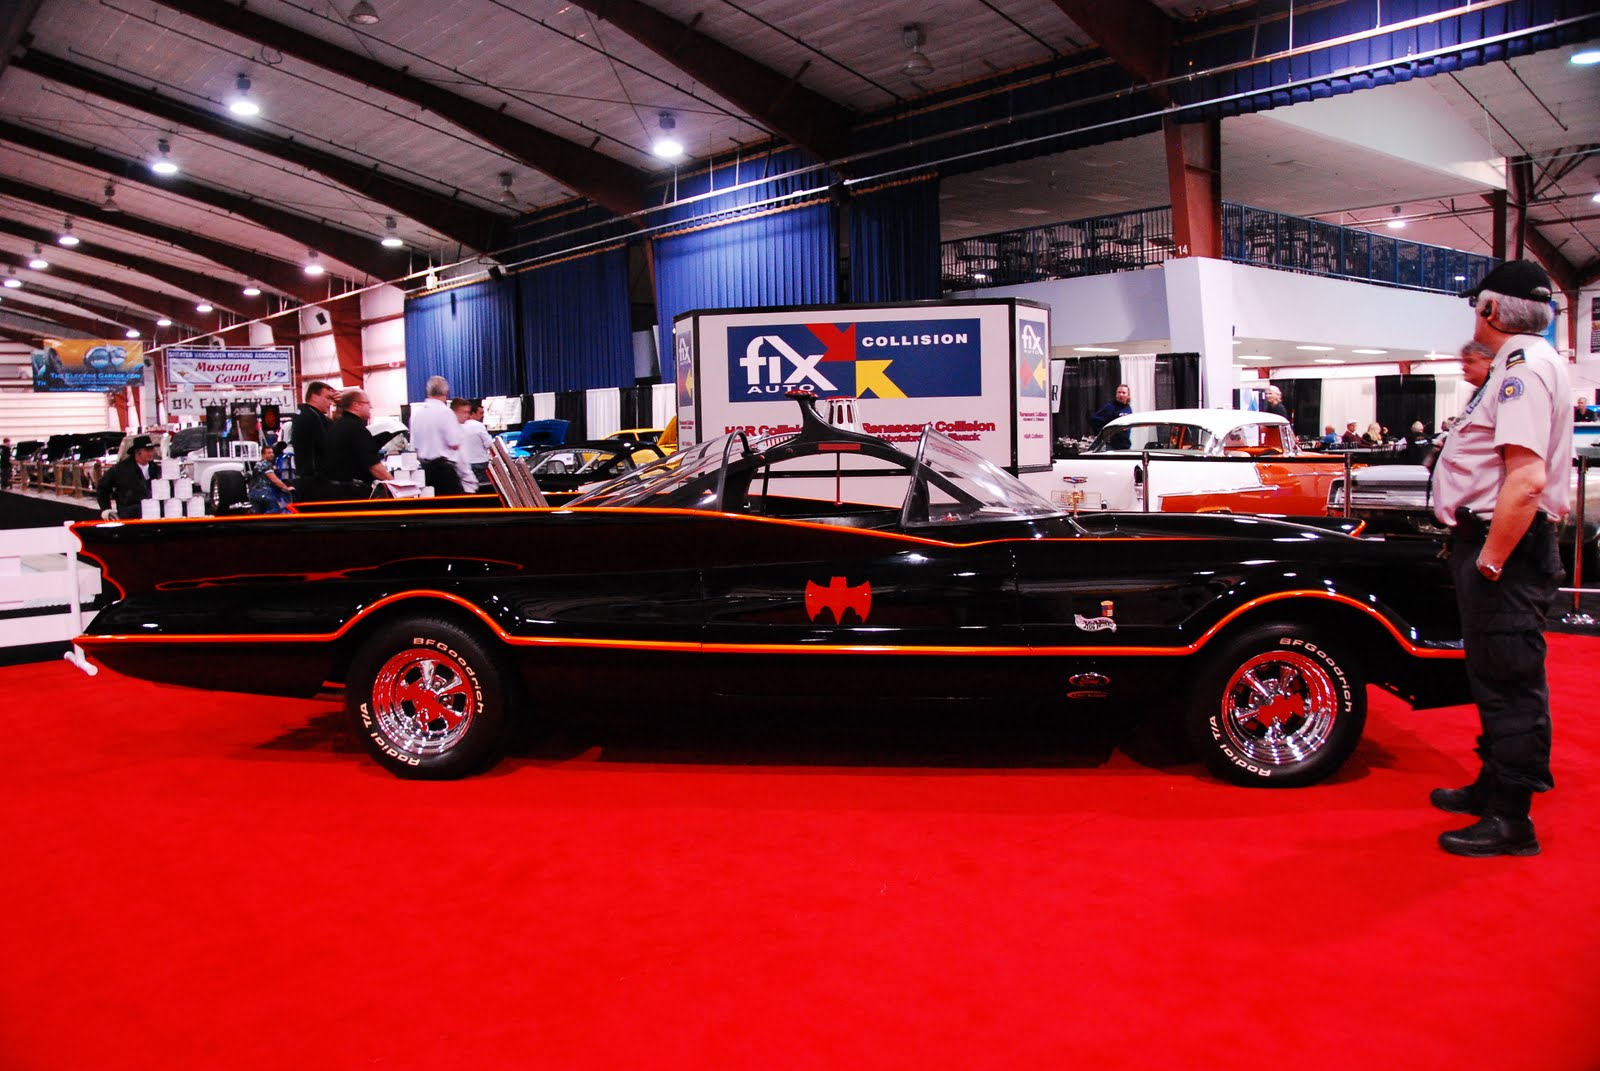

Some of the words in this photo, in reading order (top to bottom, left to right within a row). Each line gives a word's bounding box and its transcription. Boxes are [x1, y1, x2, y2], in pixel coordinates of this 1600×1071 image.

[1177, 244, 1188, 255] 14
[1021, 324, 1044, 355] fix
[196, 362, 250, 373] Mustang
[739, 335, 838, 391] fix
[862, 334, 968, 347] COLLISION
[215, 371, 272, 383] Country!
[747, 383, 815, 394] AUTO
[935, 420, 996, 433] Collision
[413, 637, 484, 714] BFGoodrich
[1279, 637, 1353, 713] BFGoodrich
[359, 702, 373, 728] T/A
[1209, 715, 1222, 741] T/A
[370, 732, 421, 766] Radial
[1219, 743, 1272, 777] Radial
